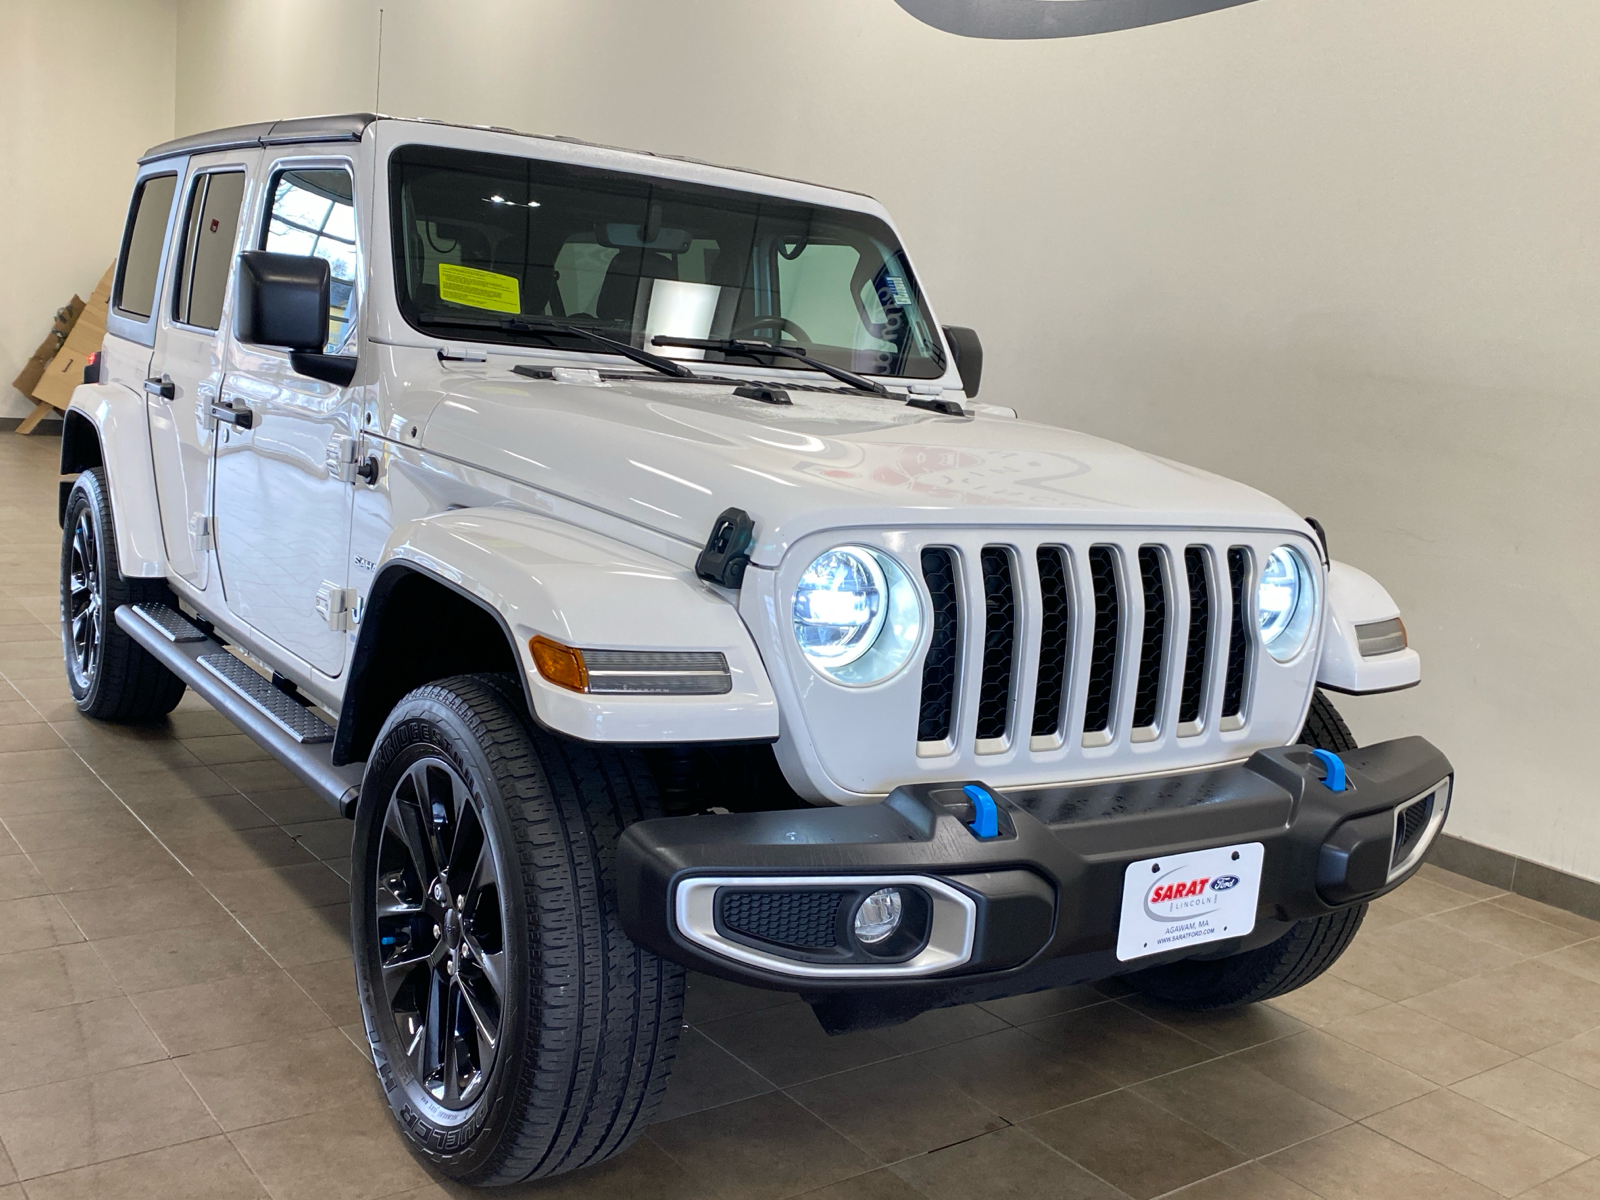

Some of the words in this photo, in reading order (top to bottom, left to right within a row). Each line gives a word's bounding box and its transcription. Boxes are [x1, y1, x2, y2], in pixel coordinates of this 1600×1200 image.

[354, 555, 377, 572] SAHA
[1150, 877, 1211, 904] SARAT
[1213, 876, 1238, 890] Ford
[1175, 897, 1212, 909] LINCOLN
[1198, 920, 1209, 928] MA
[1157, 928, 1215, 944] WWW.SARATFORD.COM
[399, 1096, 489, 1150] DUELER
